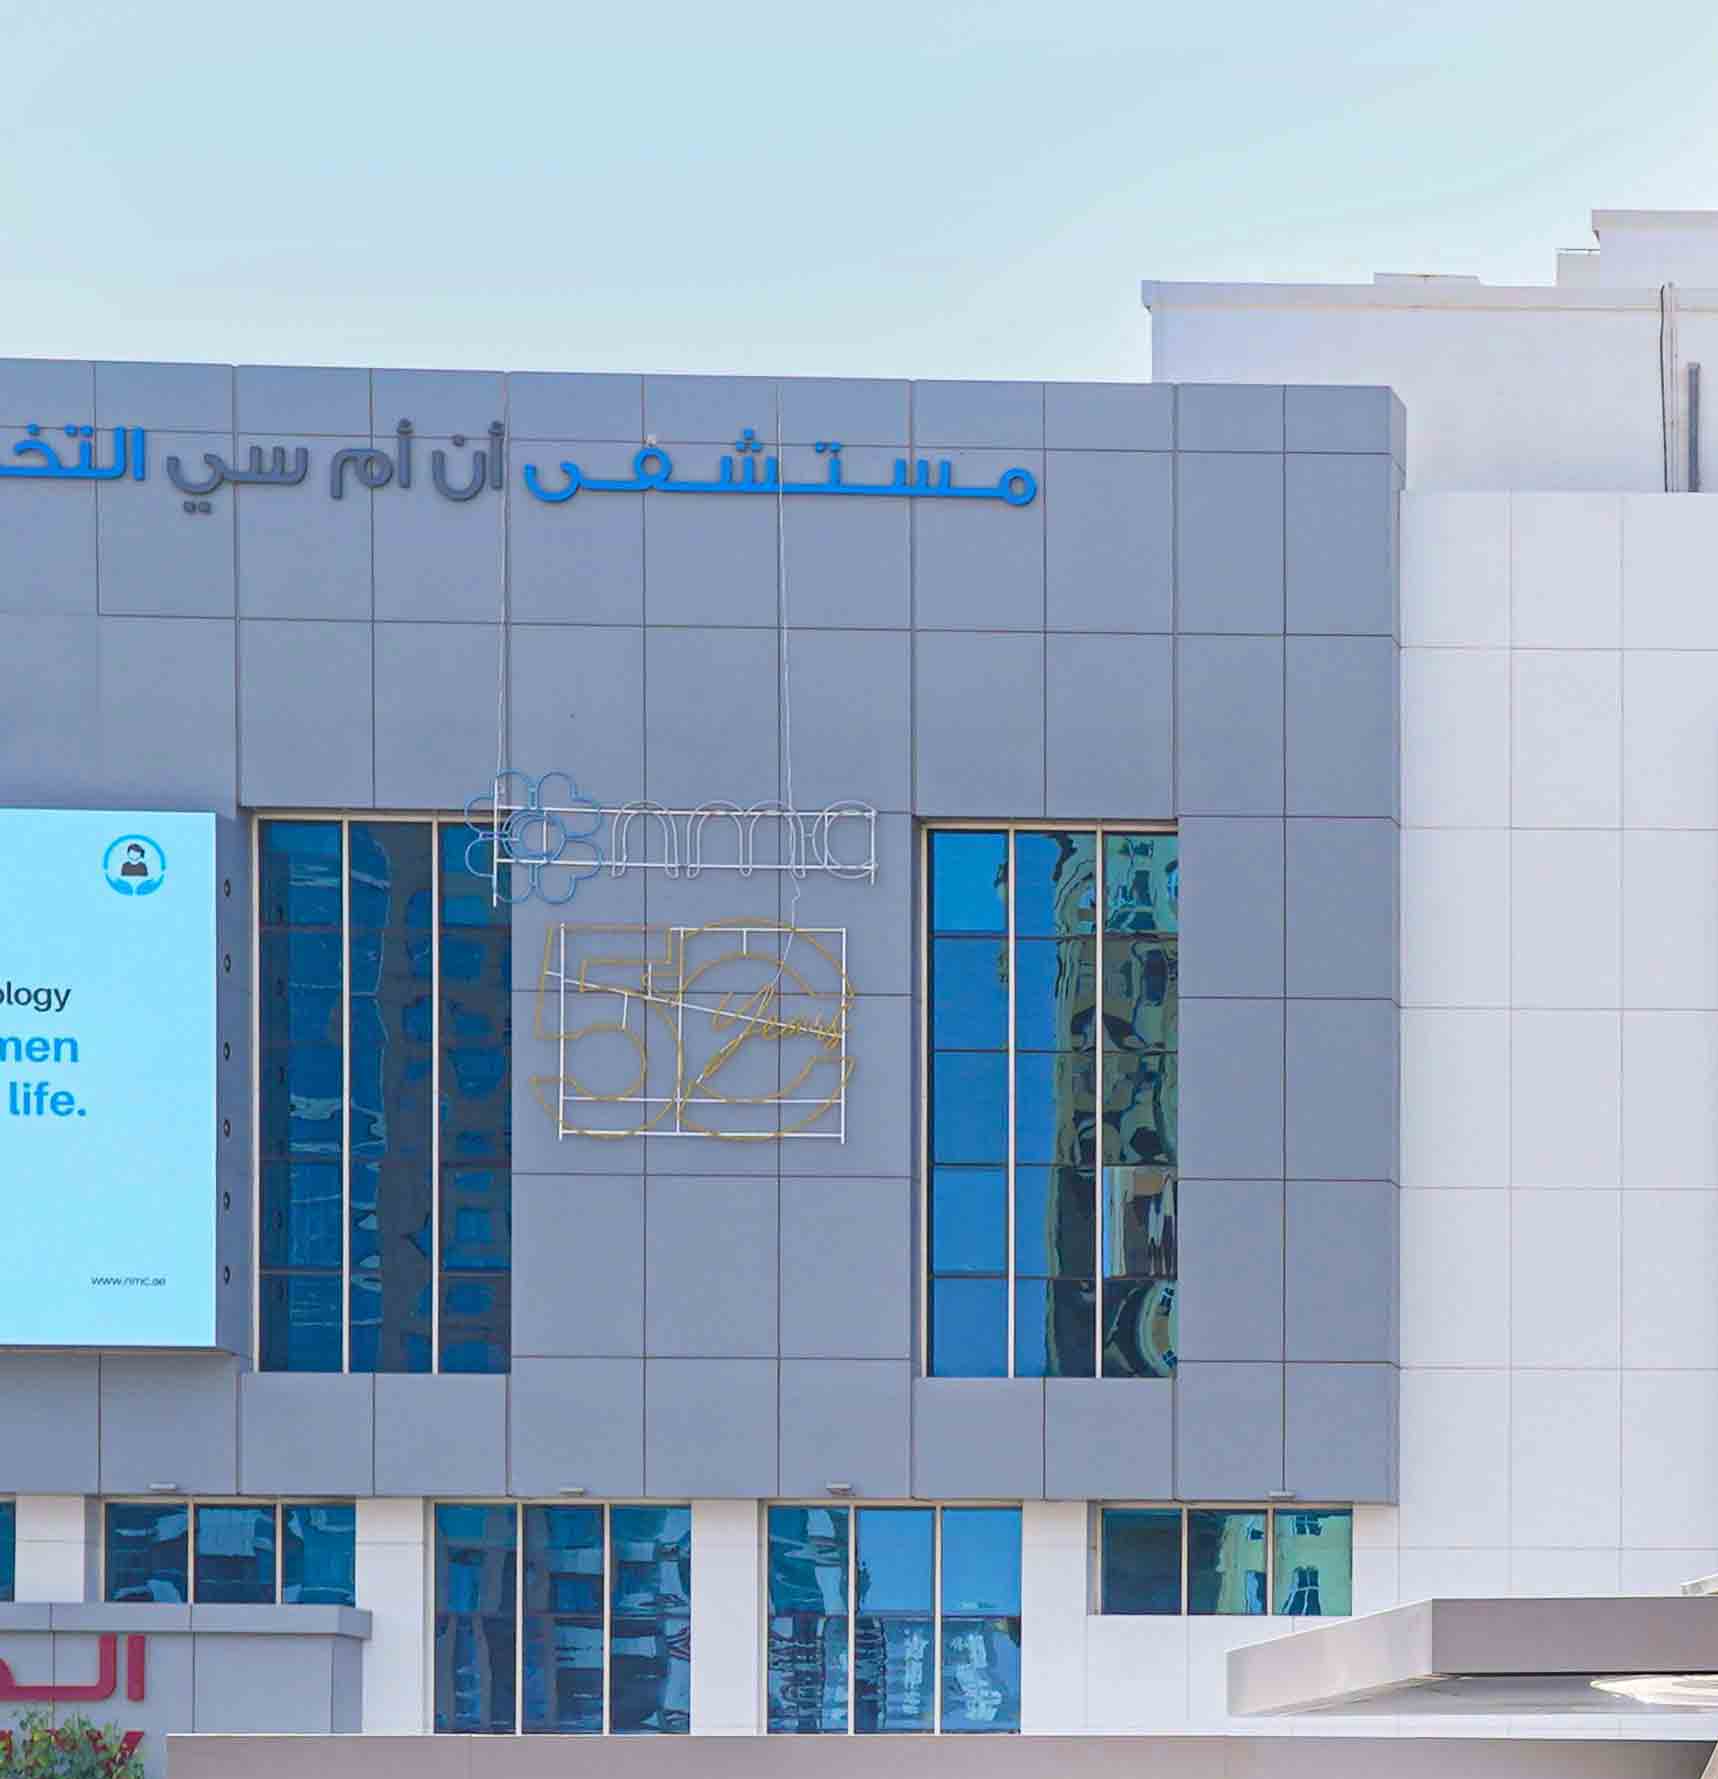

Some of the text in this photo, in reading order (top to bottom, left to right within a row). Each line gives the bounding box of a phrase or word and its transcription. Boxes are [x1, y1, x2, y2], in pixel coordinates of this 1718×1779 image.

[0, 418, 1036, 514] مستشفى أن أم سي التخ
[0, 981, 72, 1012] logy
[9, 1081, 87, 1117] life.
